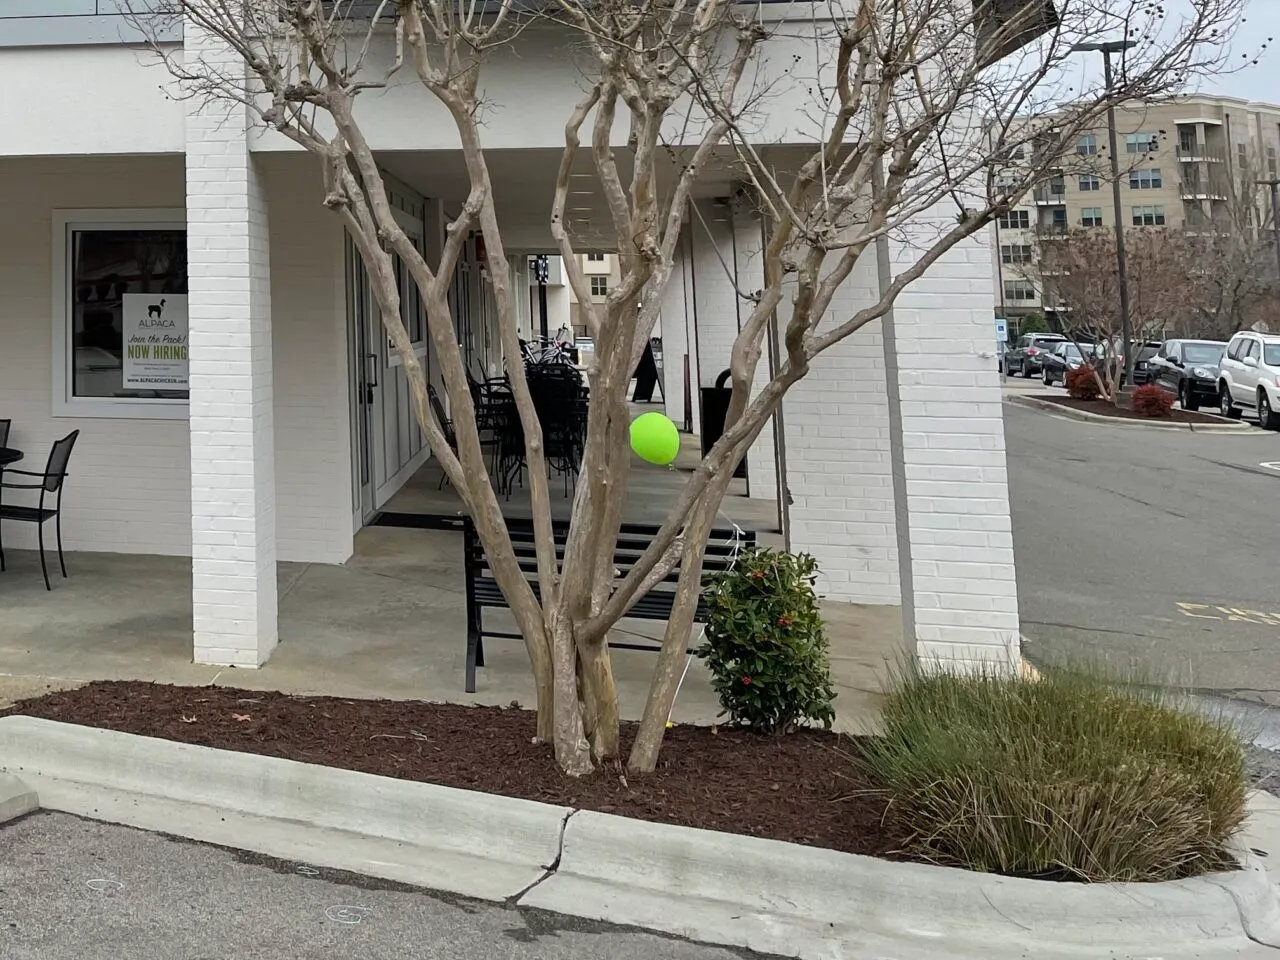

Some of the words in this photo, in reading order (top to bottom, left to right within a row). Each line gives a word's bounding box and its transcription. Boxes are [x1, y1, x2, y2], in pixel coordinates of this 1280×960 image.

[139, 320, 175, 328] ALPACA
[128, 334, 145, 343] Join
[148, 335, 160, 343] the
[128, 345, 149, 359] NOW
[153, 346, 187, 360] HIRING
